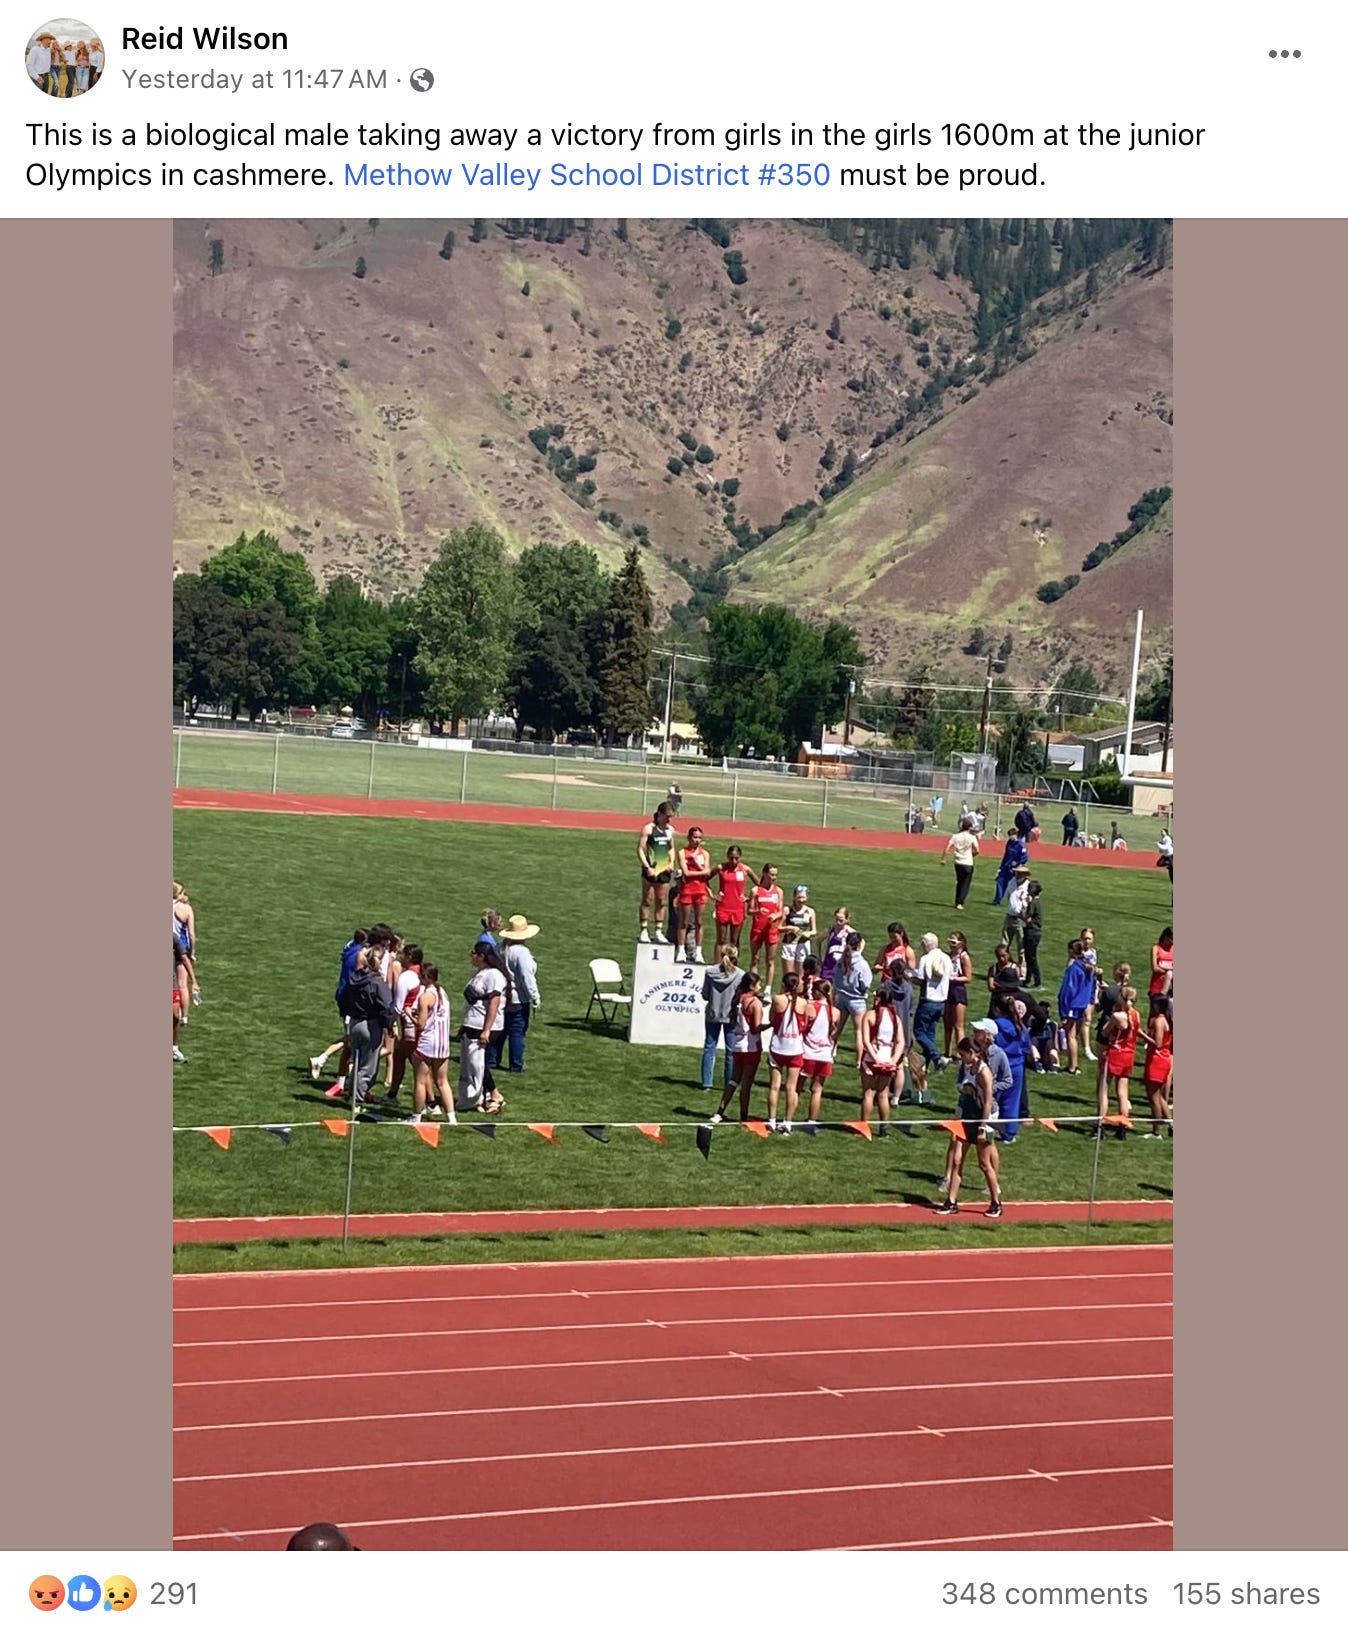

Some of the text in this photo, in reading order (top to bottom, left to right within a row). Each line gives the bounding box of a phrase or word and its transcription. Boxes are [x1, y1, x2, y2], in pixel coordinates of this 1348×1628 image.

[651, 948, 660, 961] 1
[683, 968, 694, 979] 2
[640, 980, 687, 1004] CASHMERE
[662, 992, 696, 1004] 2024
[655, 1004, 701, 1014] OLYMPICS
